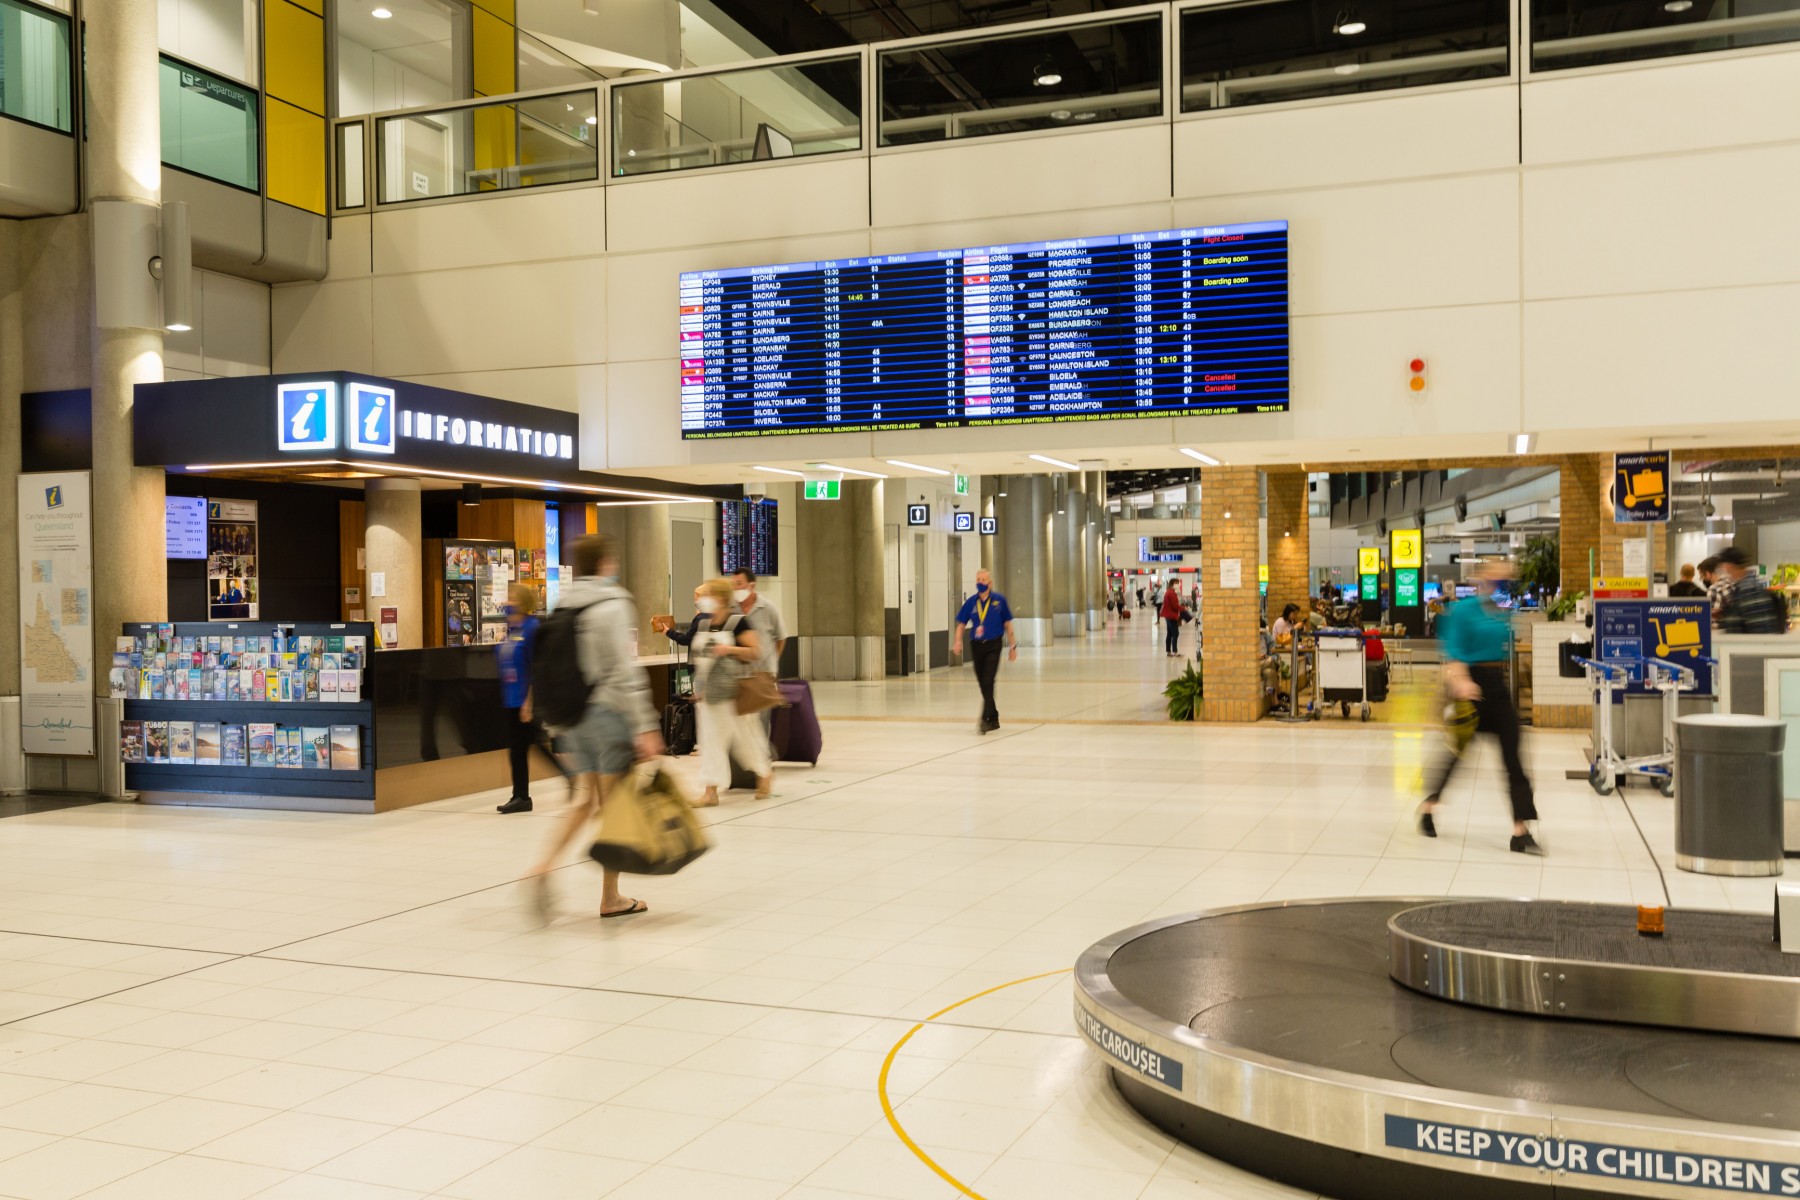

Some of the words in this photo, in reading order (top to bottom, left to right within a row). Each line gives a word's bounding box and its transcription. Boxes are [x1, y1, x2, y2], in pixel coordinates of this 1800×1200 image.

[1204, 256, 1231, 264] Boarding
[1204, 278, 1231, 286] Boarding
[753, 292, 777, 300] MACKAY
[753, 300, 790, 308] TOWNSVILLE
[753, 317, 790, 326] TOWNSVILLE
[1160, 324, 1177, 332] 12:10
[754, 372, 791, 380] TOWNSVILLE
[402, 410, 572, 459] INFORMATION
[1401, 540, 1412, 556] 3
[1366, 555, 1372, 566] 2
[1087, 1014, 1100, 1044] THE
[1102, 1028, 1165, 1080] CAROUSEL
[1416, 1123, 1492, 1156] KEEP
[1497, 1134, 1589, 1170] YOUR
[1596, 1147, 1770, 1192] CHILDREN
